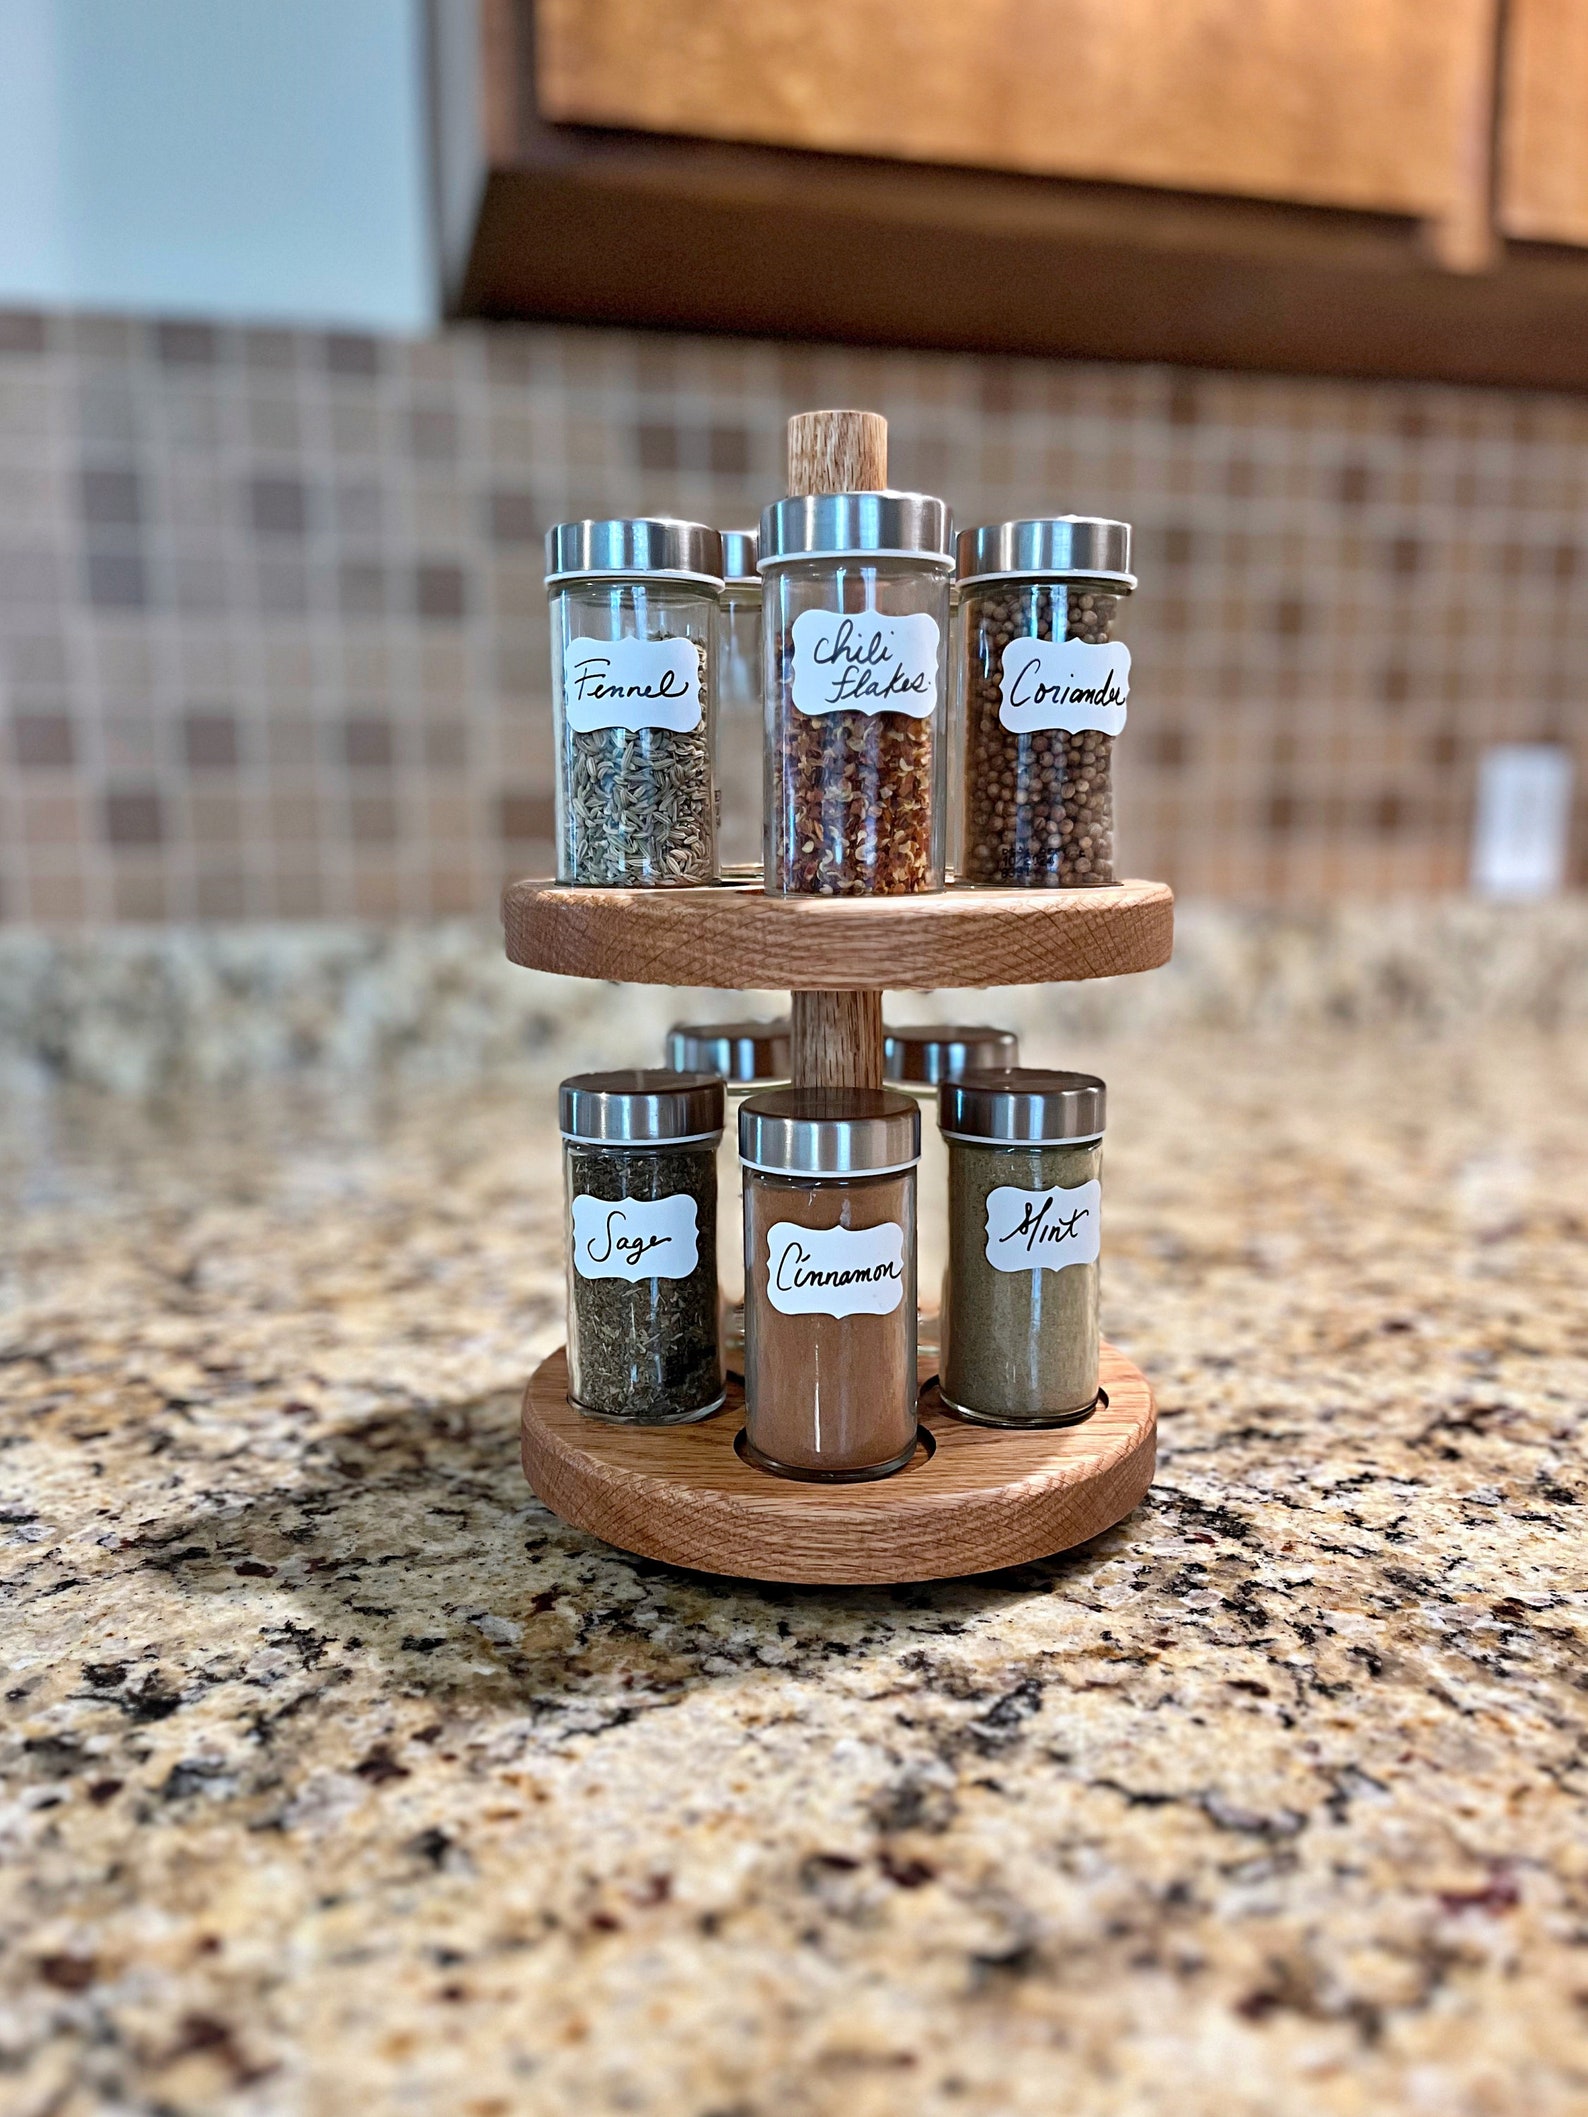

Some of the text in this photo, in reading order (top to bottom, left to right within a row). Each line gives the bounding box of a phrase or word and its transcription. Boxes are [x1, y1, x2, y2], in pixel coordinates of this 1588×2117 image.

[574, 658, 689, 701] Fennel
[1010, 658, 1126, 707] Coriander
[587, 1210, 673, 1266] Sage
[999, 1196, 1089, 1252] Mint
[776, 1242, 902, 1292] Cinnamon
